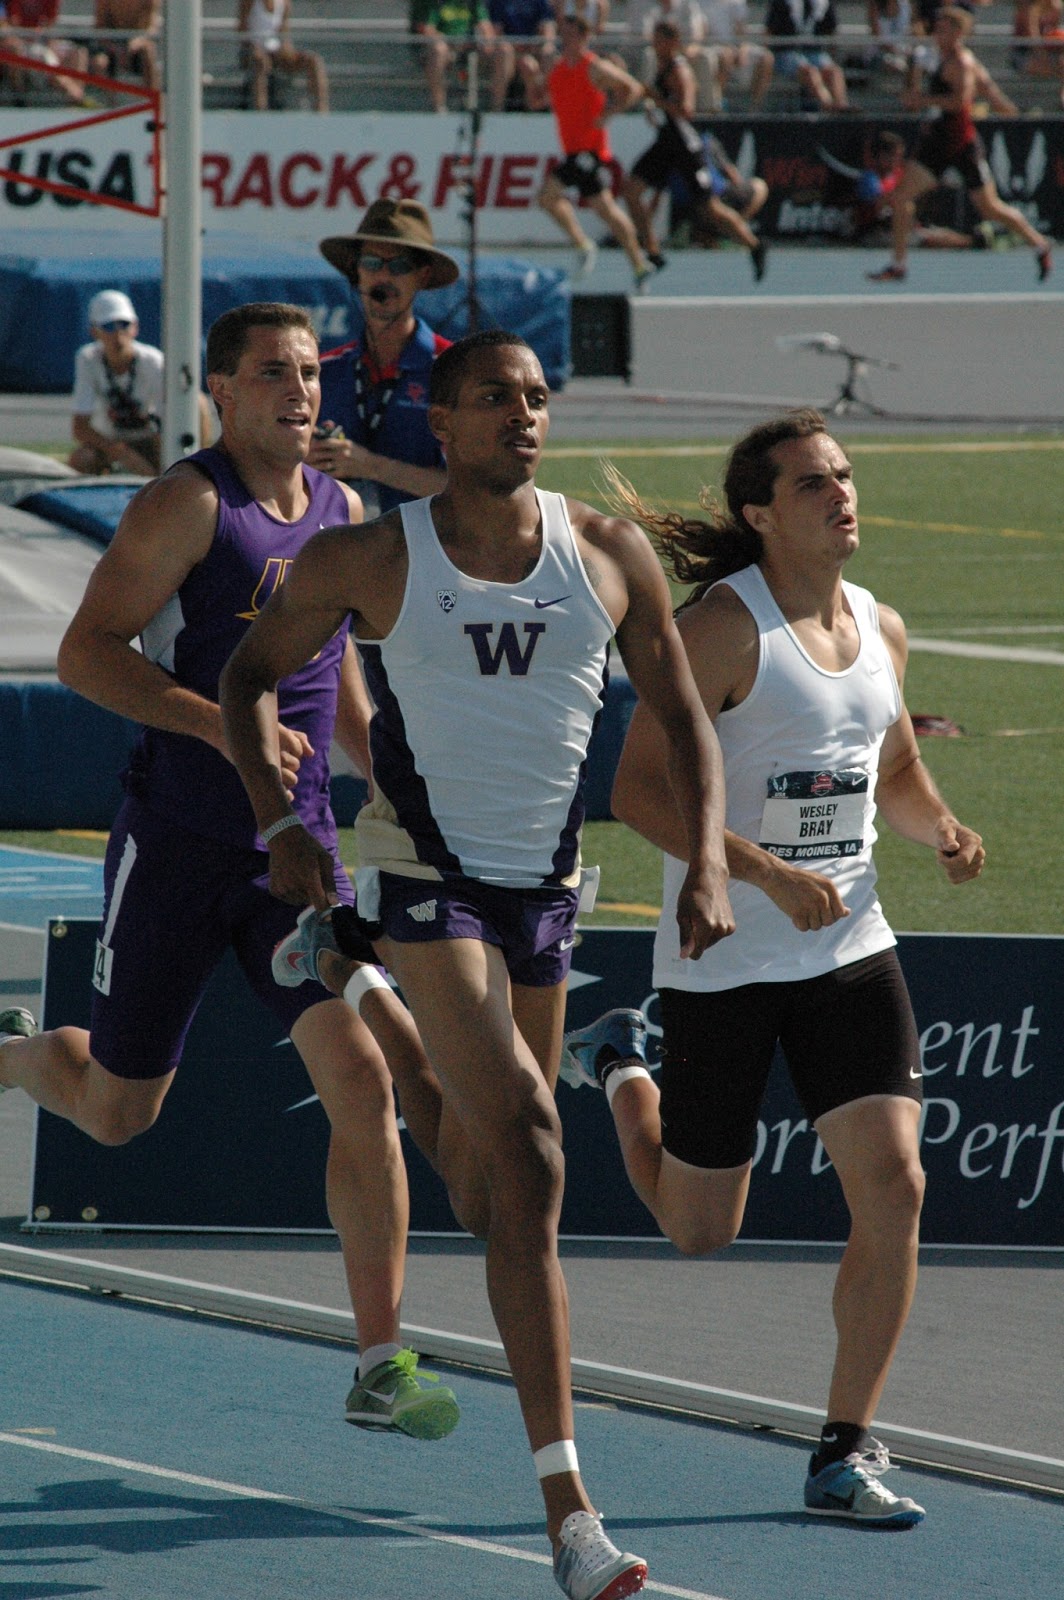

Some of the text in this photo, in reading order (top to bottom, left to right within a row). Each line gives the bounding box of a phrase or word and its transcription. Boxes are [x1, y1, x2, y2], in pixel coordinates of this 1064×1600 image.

[5, 152, 135, 207] USA
[146, 153, 375, 208] RACK
[377, 153, 421, 205] &
[442, 600, 453, 610] 12
[463, 622, 546, 676] W
[800, 803, 838, 818] WESLEY
[799, 820, 833, 838] BRAY
[767, 843, 857, 857] DES MOINES, IA
[406, 899, 438, 922] W
[917, 1097, 1064, 1210] Perf
